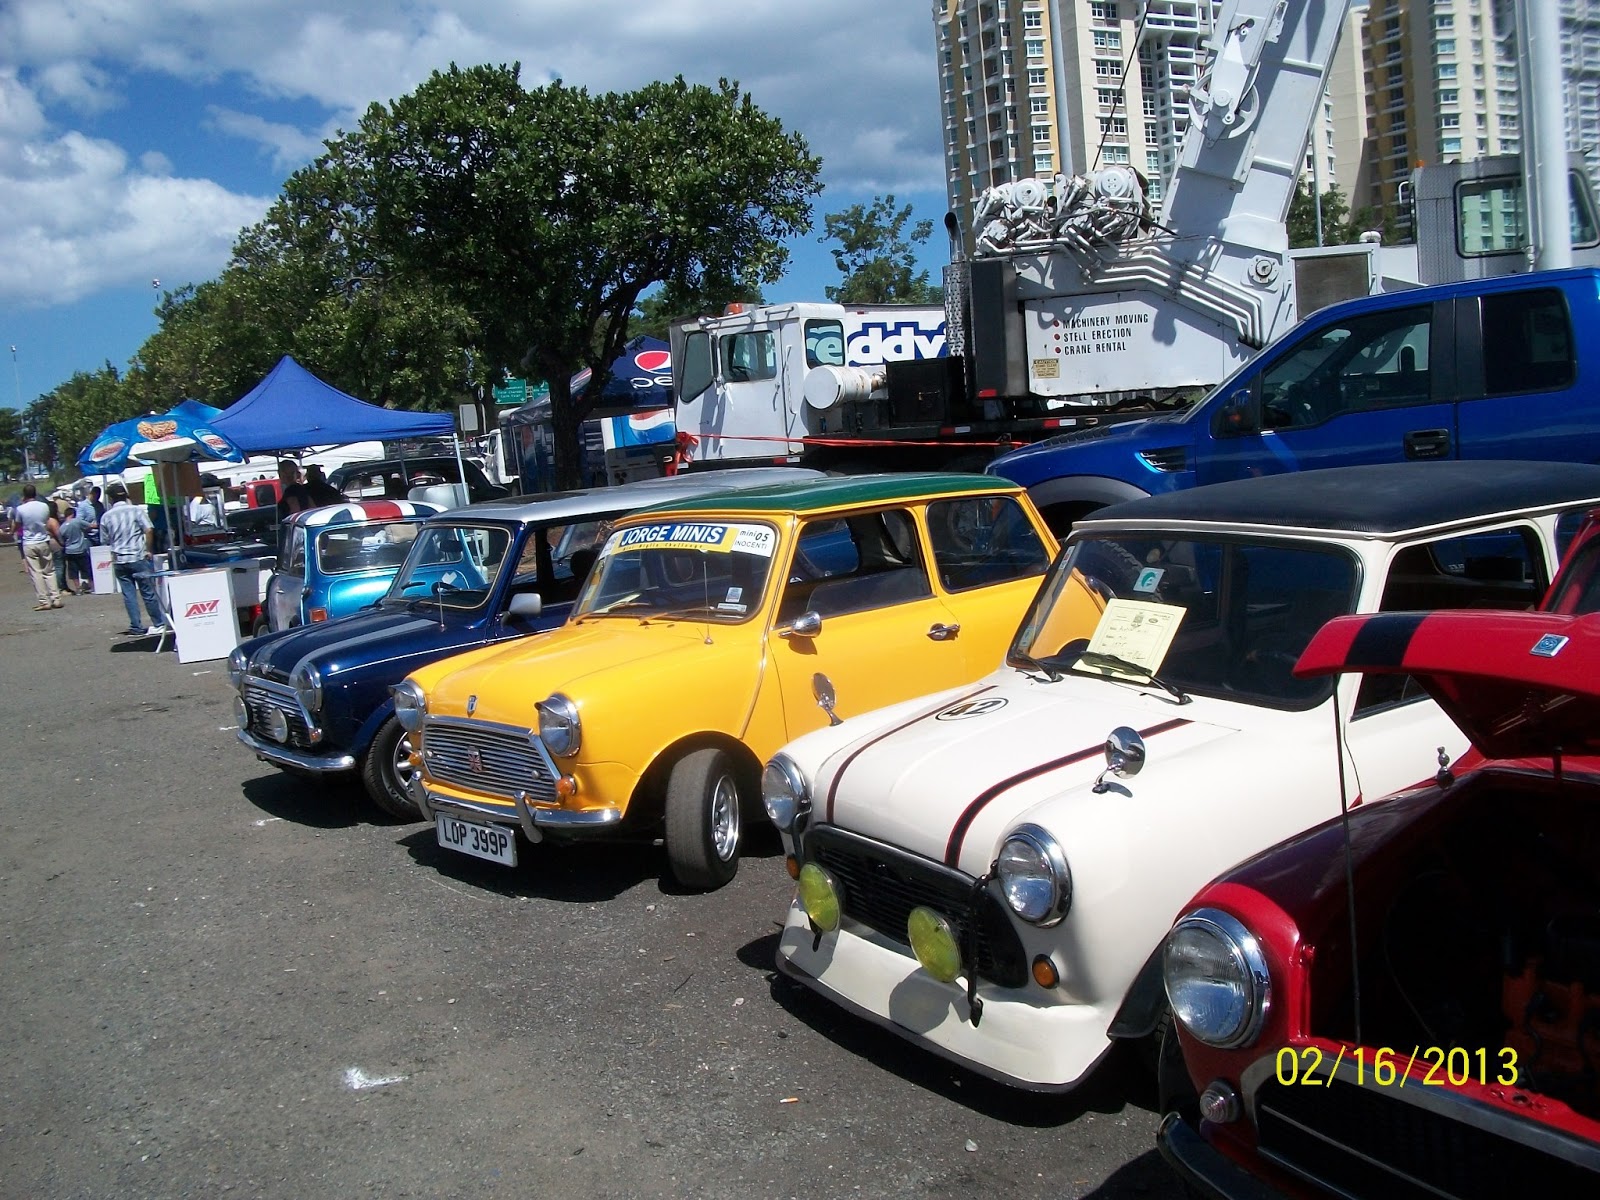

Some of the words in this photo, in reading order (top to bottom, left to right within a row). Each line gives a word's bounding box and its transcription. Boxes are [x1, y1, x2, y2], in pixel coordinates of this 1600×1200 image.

[1062, 316, 1110, 329] MACHINERY
[1115, 313, 1149, 325] MOVING
[1091, 327, 1132, 340] ERECTION
[1064, 344, 1091, 356] CRANE
[1095, 341, 1127, 353] RENTAL
[621, 525, 671, 546] JORGE
[669, 525, 723, 543] MINIS
[941, 700, 1002, 717] 42
[442, 818, 467, 846] LOP
[470, 826, 508, 857] 399P
